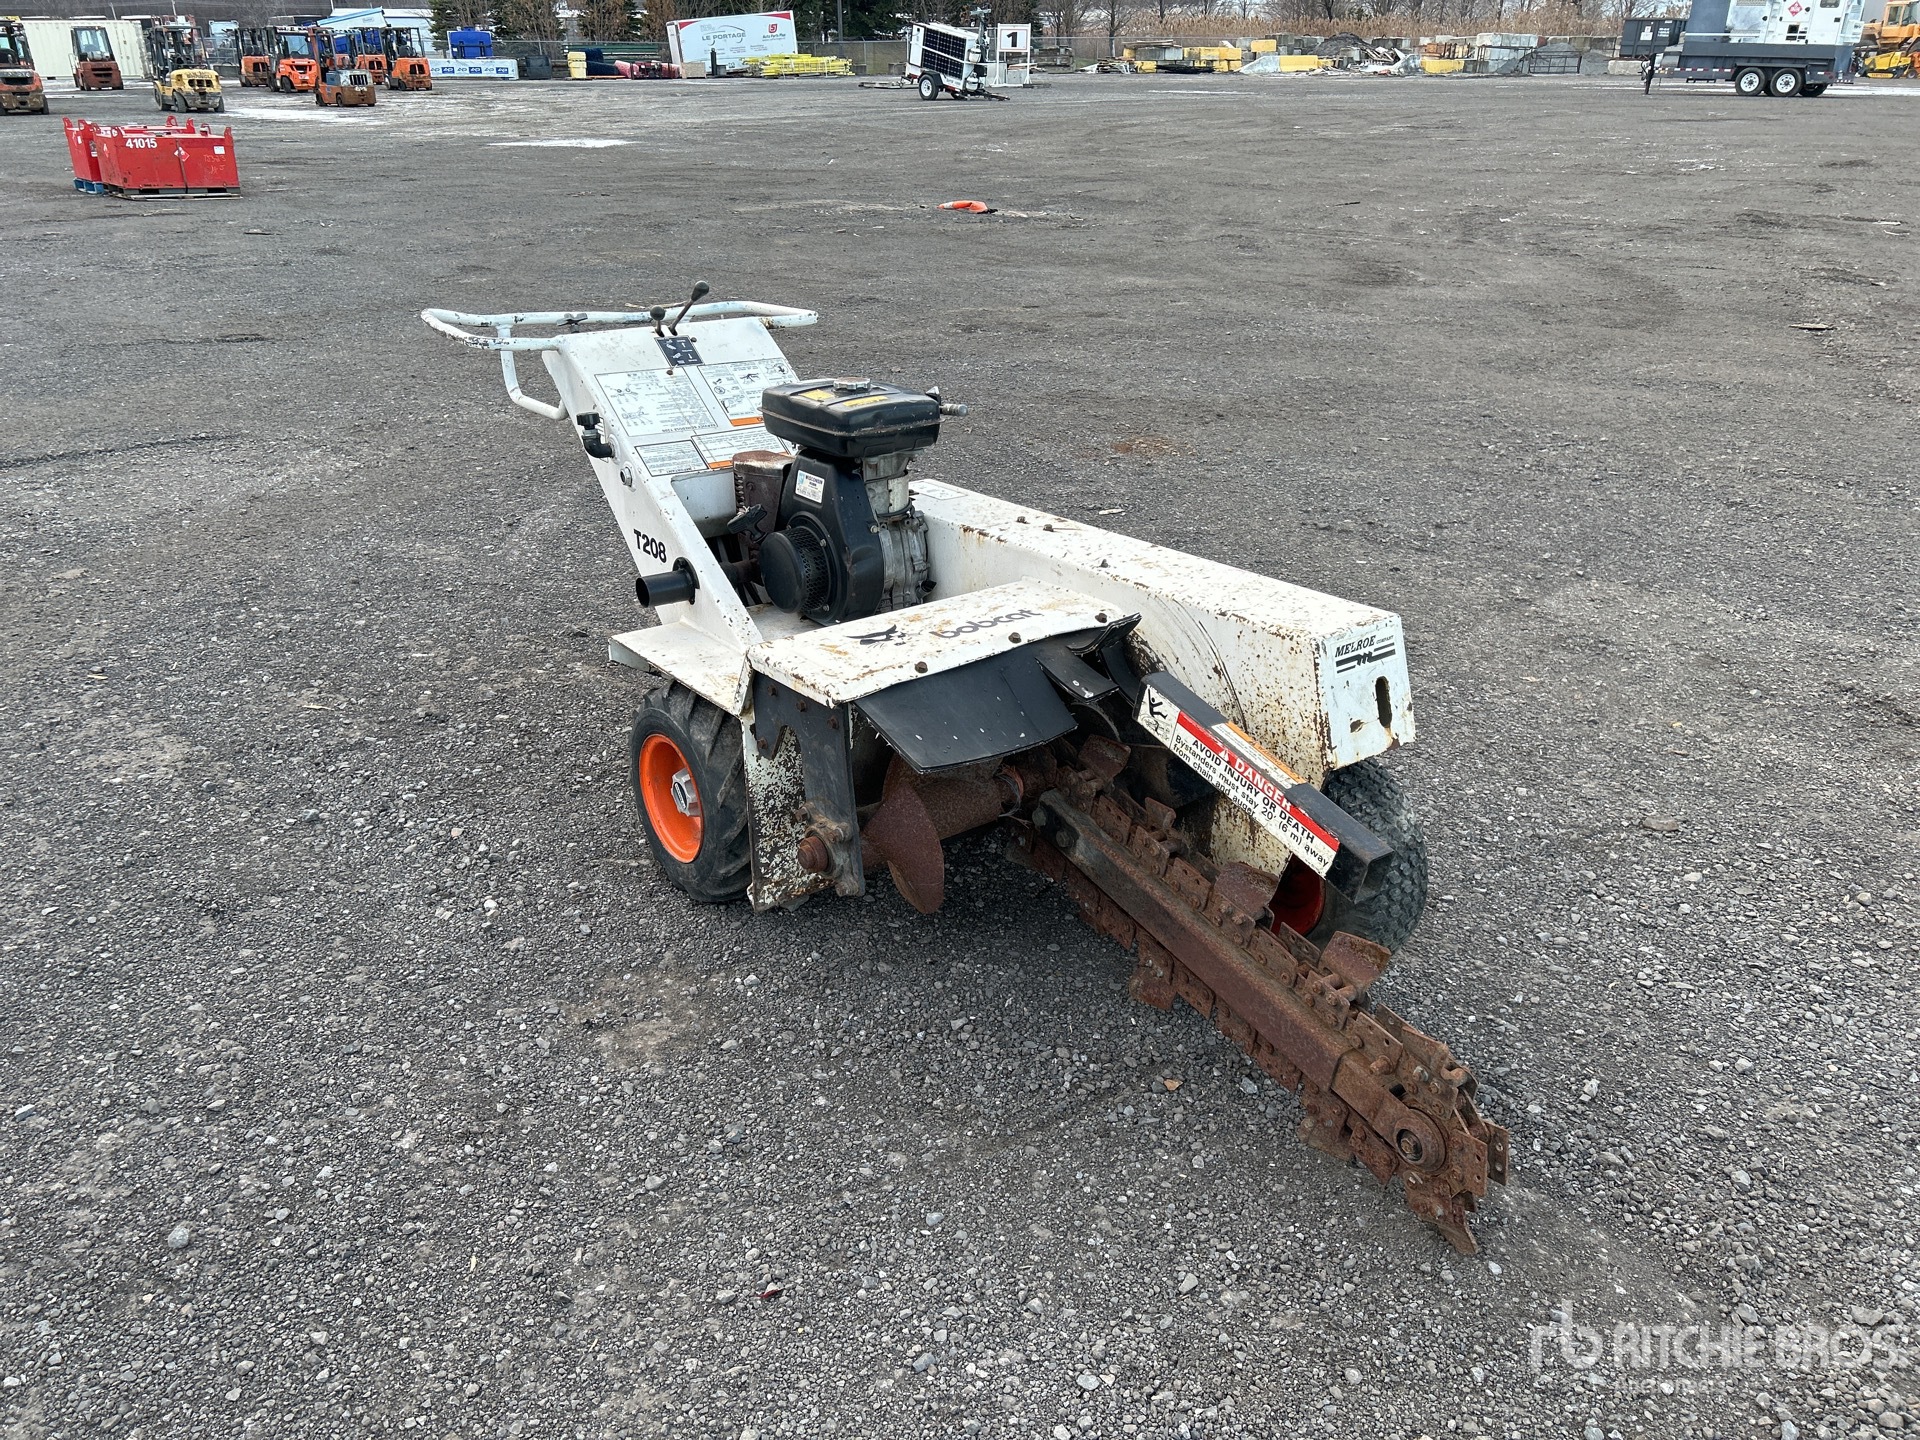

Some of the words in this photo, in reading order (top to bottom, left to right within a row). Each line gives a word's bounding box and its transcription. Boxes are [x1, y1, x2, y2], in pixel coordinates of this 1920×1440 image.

[712, 32, 747, 40] PORTAGE
[1006, 31, 1018, 48] 1
[125, 138, 158, 149] 41015
[633, 528, 667, 564] T208
[928, 607, 1042, 640] bobcat
[1334, 634, 1377, 658] MELROE
[1173, 743, 1191, 763] from
[1192, 761, 1213, 782] chain
[1215, 780, 1231, 796] and
[1234, 757, 1292, 813] DANGER
[1175, 734, 1217, 774] Bystanders
[1219, 772, 1240, 793] must
[1240, 791, 1259, 809] stay
[1304, 843, 1329, 868] away
[1192, 739, 1222, 767] AVOID
[1223, 764, 1260, 798] INJURY
[1262, 796, 1277, 813] OR
[1279, 810, 1315, 844] DEATH
